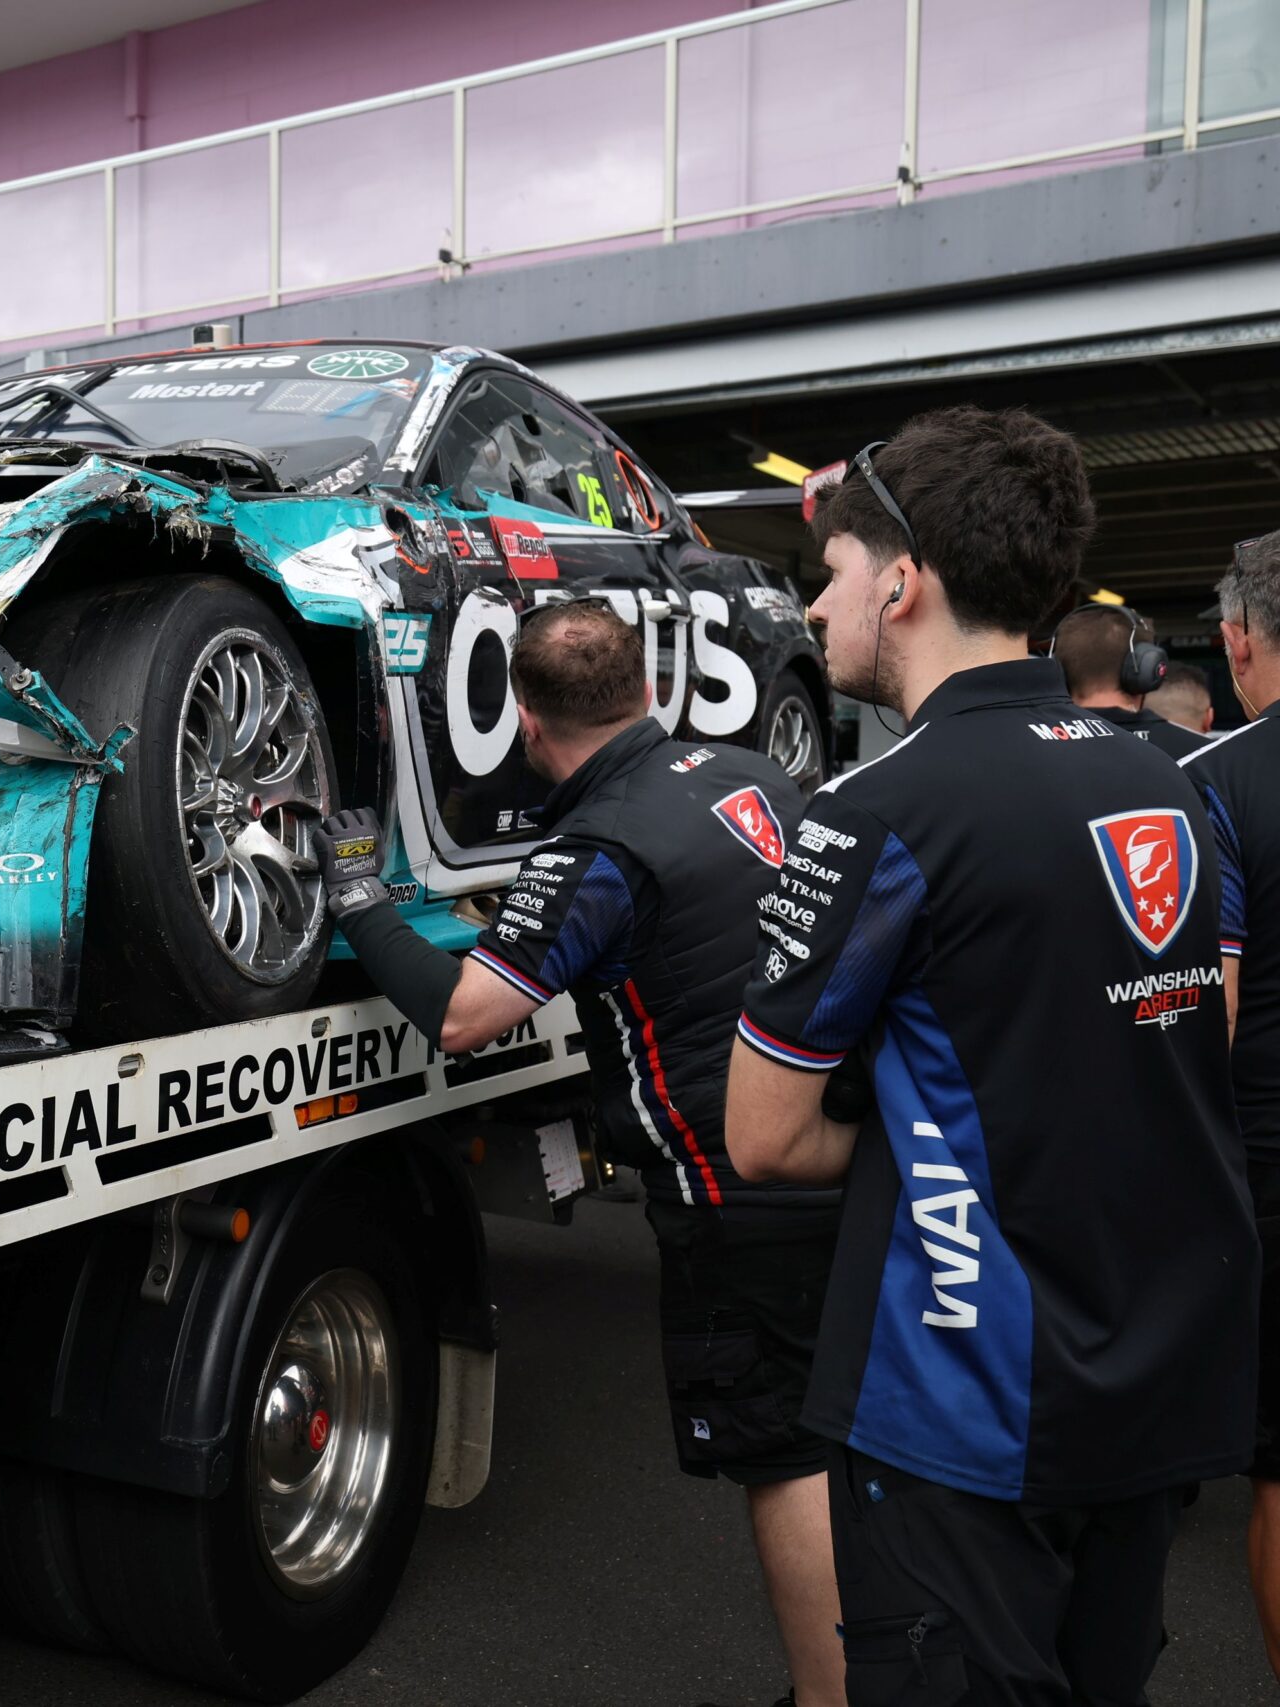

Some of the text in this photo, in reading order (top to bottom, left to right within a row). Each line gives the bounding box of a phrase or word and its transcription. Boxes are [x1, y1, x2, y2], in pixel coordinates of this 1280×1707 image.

[109, 355, 301, 378] ILTERS
[326, 355, 395, 367] NTK
[128, 380, 266, 400] Mostert
[577, 472, 614, 529] 25
[383, 618, 428, 667] 25
[1028, 718, 1094, 741] Mobil
[670, 752, 704, 774] Mobil
[529, 881, 558, 896] TRANS
[791, 879, 833, 906] TRANS
[157, 1021, 410, 1134] RECOVERY
